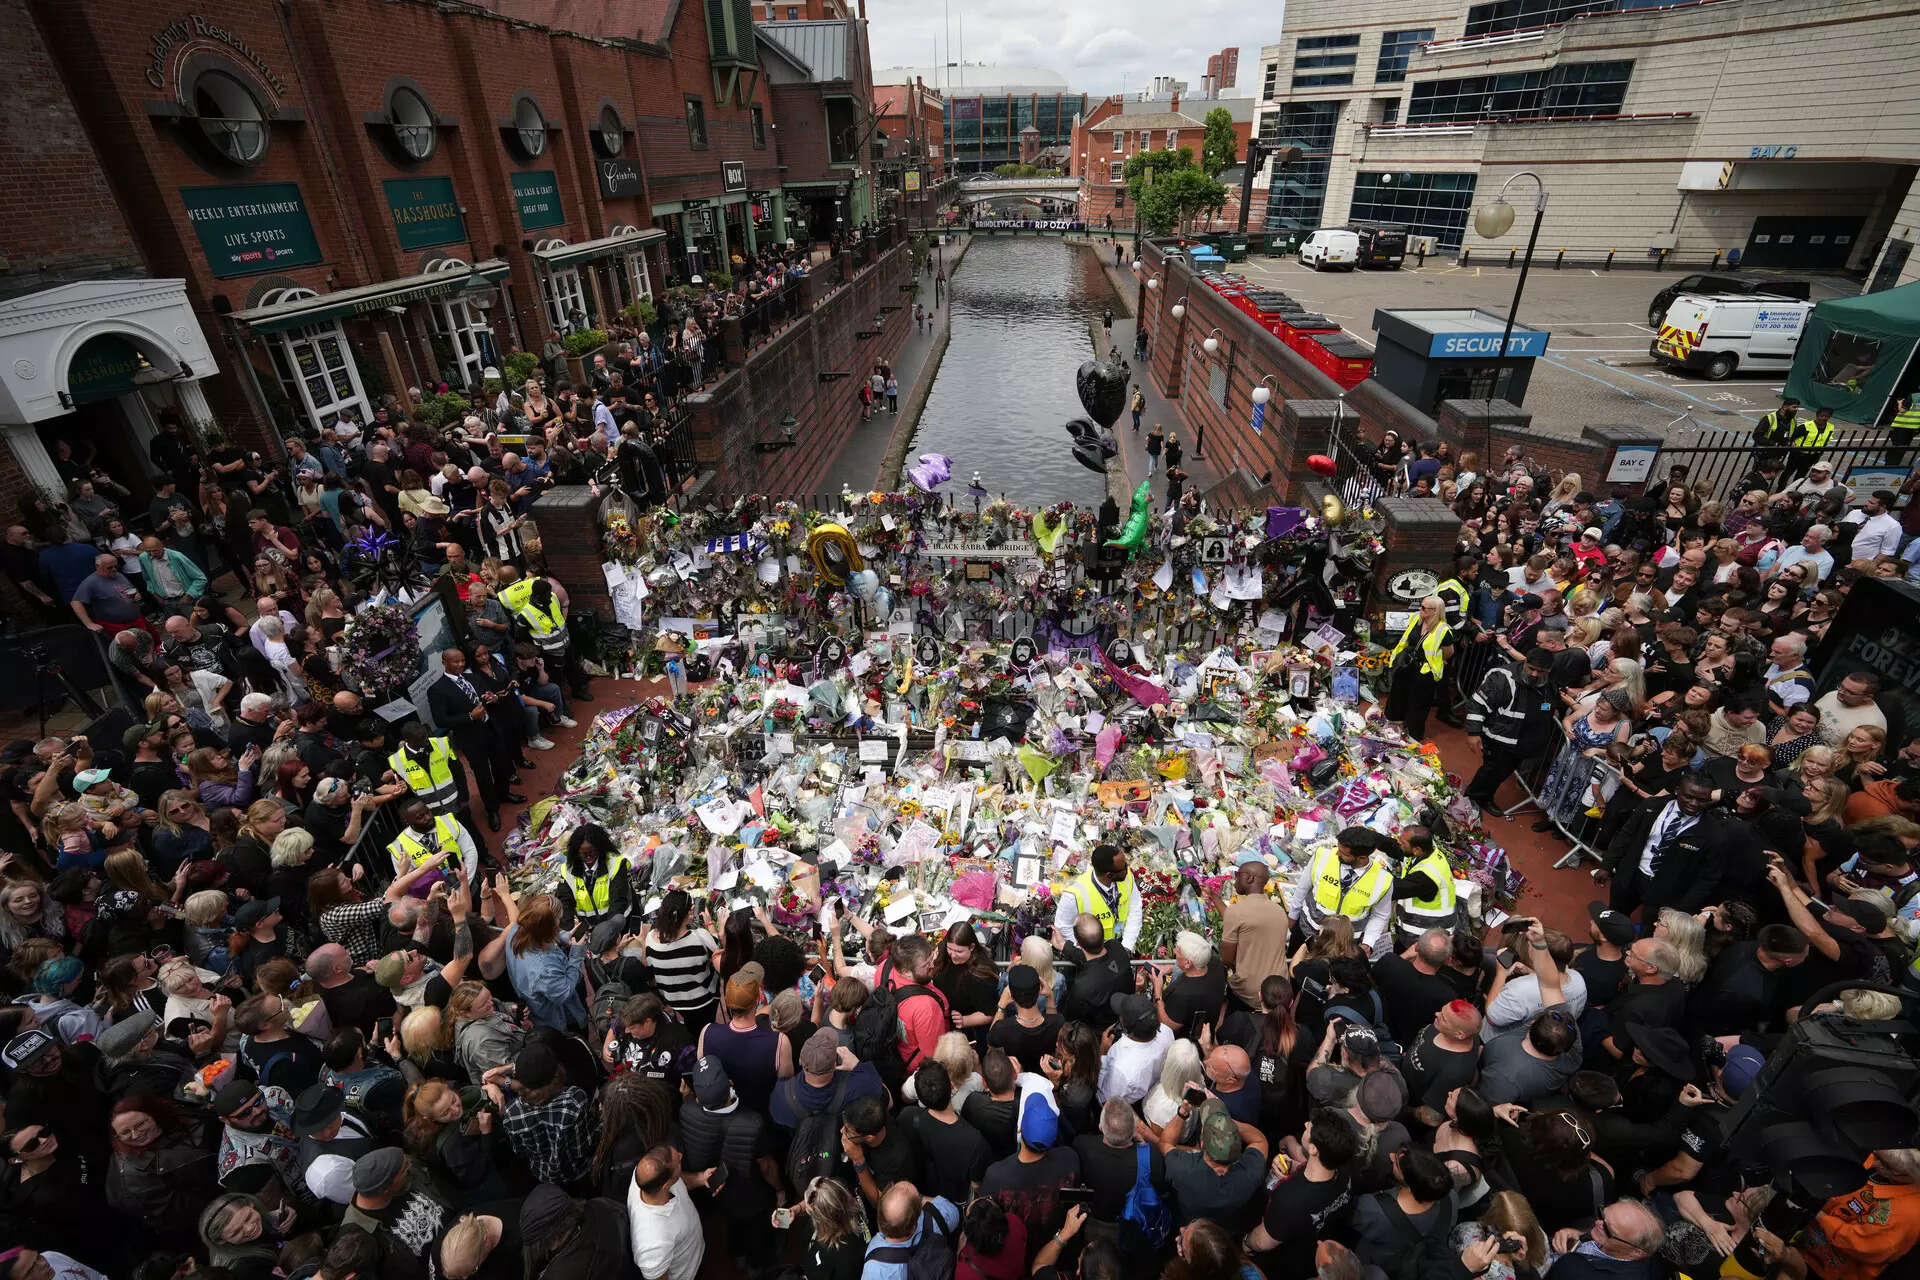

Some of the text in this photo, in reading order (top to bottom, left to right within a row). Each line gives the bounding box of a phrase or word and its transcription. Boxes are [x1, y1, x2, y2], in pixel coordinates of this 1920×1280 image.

[1750, 144, 1798, 159] BAY C
[727, 168, 742, 184] BOX
[540, 185, 553, 194] CRAFT
[228, 200, 300, 217] ENTERTAINMENT
[392, 203, 457, 224] RASSHOUSE
[537, 203, 549, 212] FOOD
[702, 212, 711, 233] BOX
[975, 221, 1071, 229] BRINDLEYPLACE RIP OZZY
[224, 229, 287, 247] LIVE SPORTS
[1445, 338, 1533, 353] SECURTY
[960, 543, 997, 551] SABBA
[999, 543, 1030, 551] BRIDGE
[1847, 632, 1920, 696] FOREV
[405, 764, 422, 774] 442
[411, 848, 428, 861] 454
[1322, 874, 1339, 887] 492
[1095, 911, 1111, 920] 433
